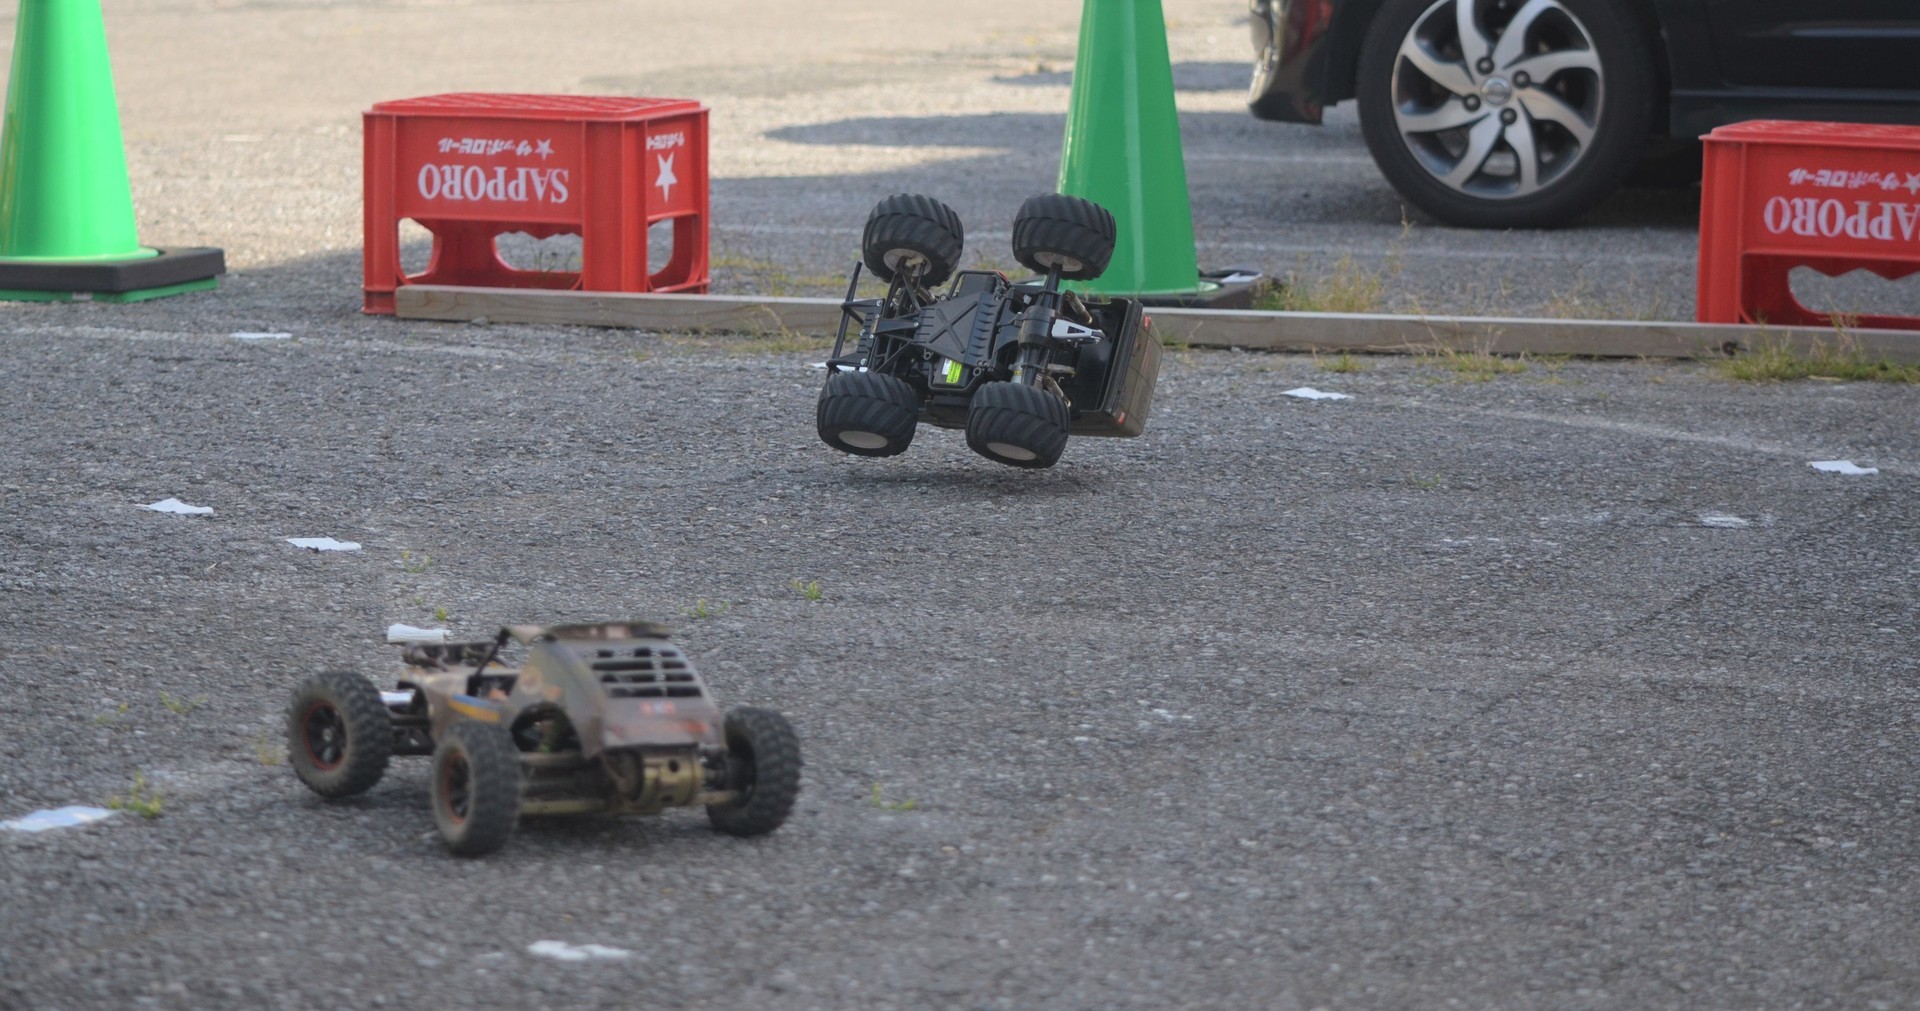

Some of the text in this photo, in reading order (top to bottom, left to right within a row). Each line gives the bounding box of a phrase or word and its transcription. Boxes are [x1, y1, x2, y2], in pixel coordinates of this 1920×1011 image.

[437, 137, 533, 156] サッポロビール
[417, 163, 569, 204] SAPPORO
[1763, 195, 1920, 241] APPORO
